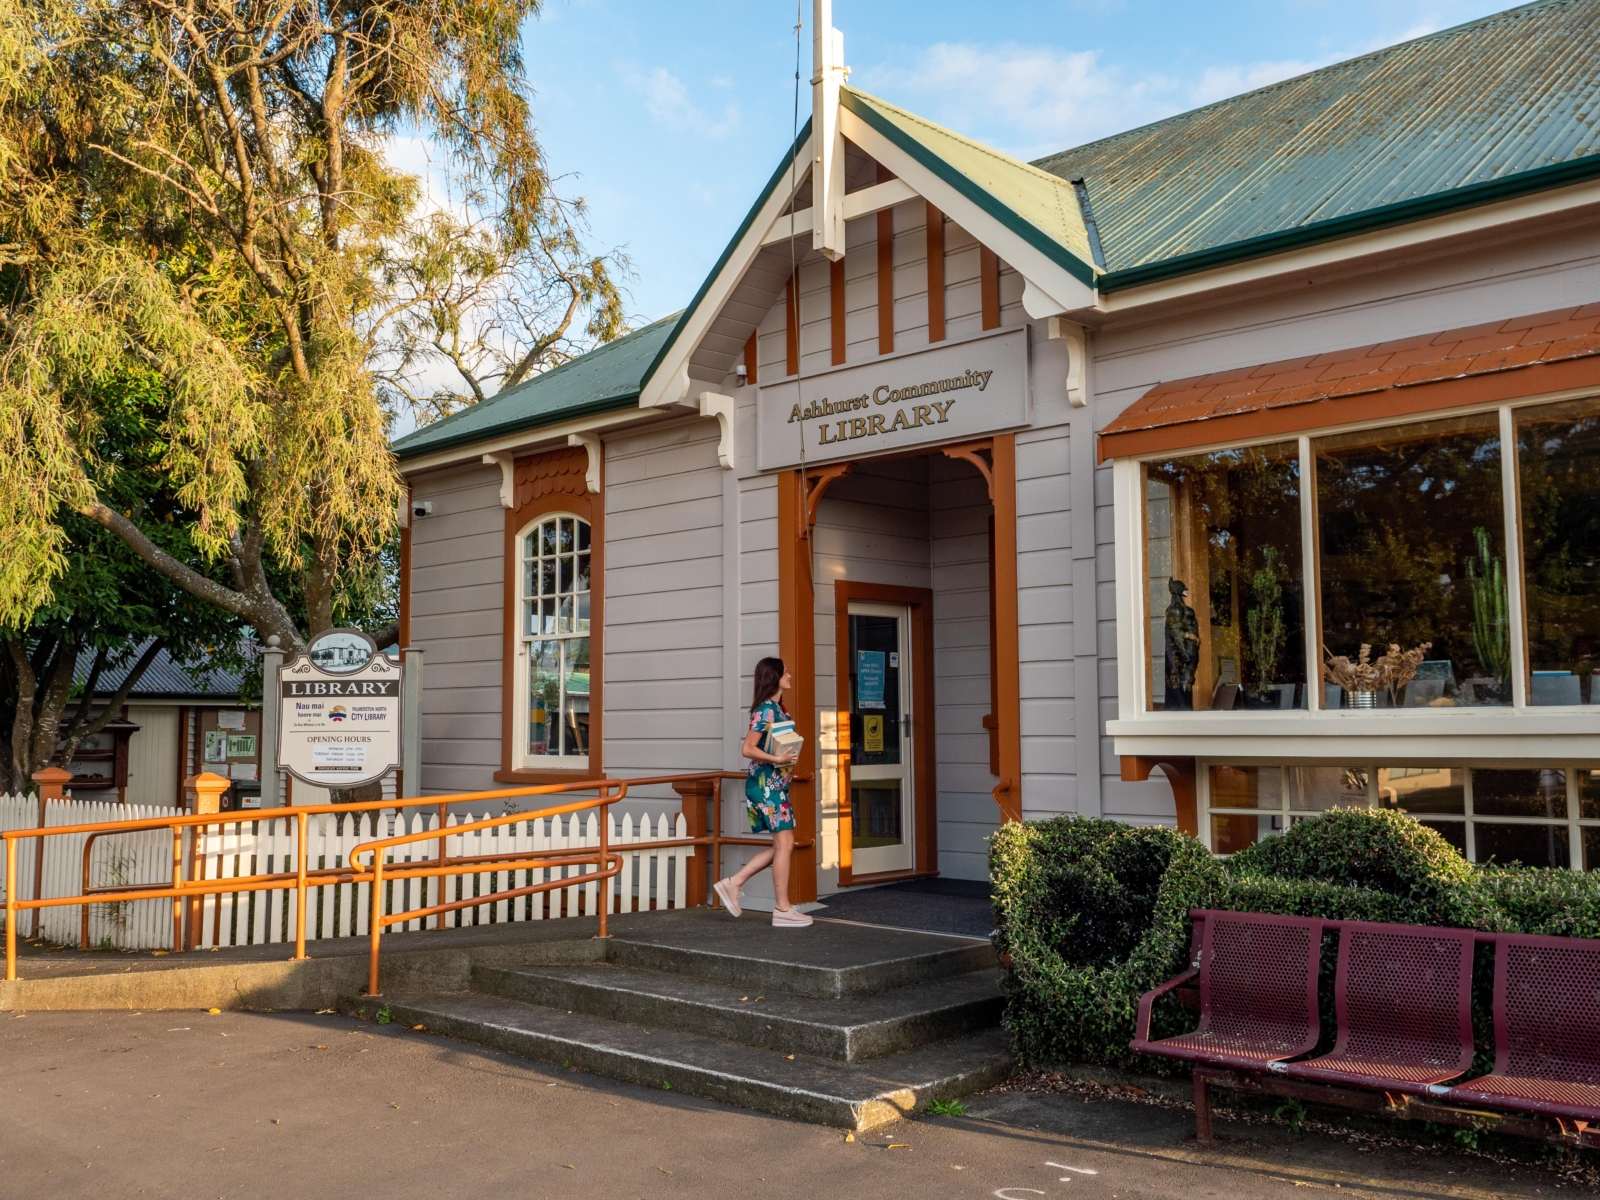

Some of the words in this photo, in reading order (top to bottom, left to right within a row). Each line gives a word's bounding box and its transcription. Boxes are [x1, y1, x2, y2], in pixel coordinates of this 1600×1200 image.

[788, 394, 868, 422] Ashhurst
[872, 369, 992, 405] Community
[819, 399, 955, 445] LIBRARY
[290, 682, 391, 696] LIBRARY
